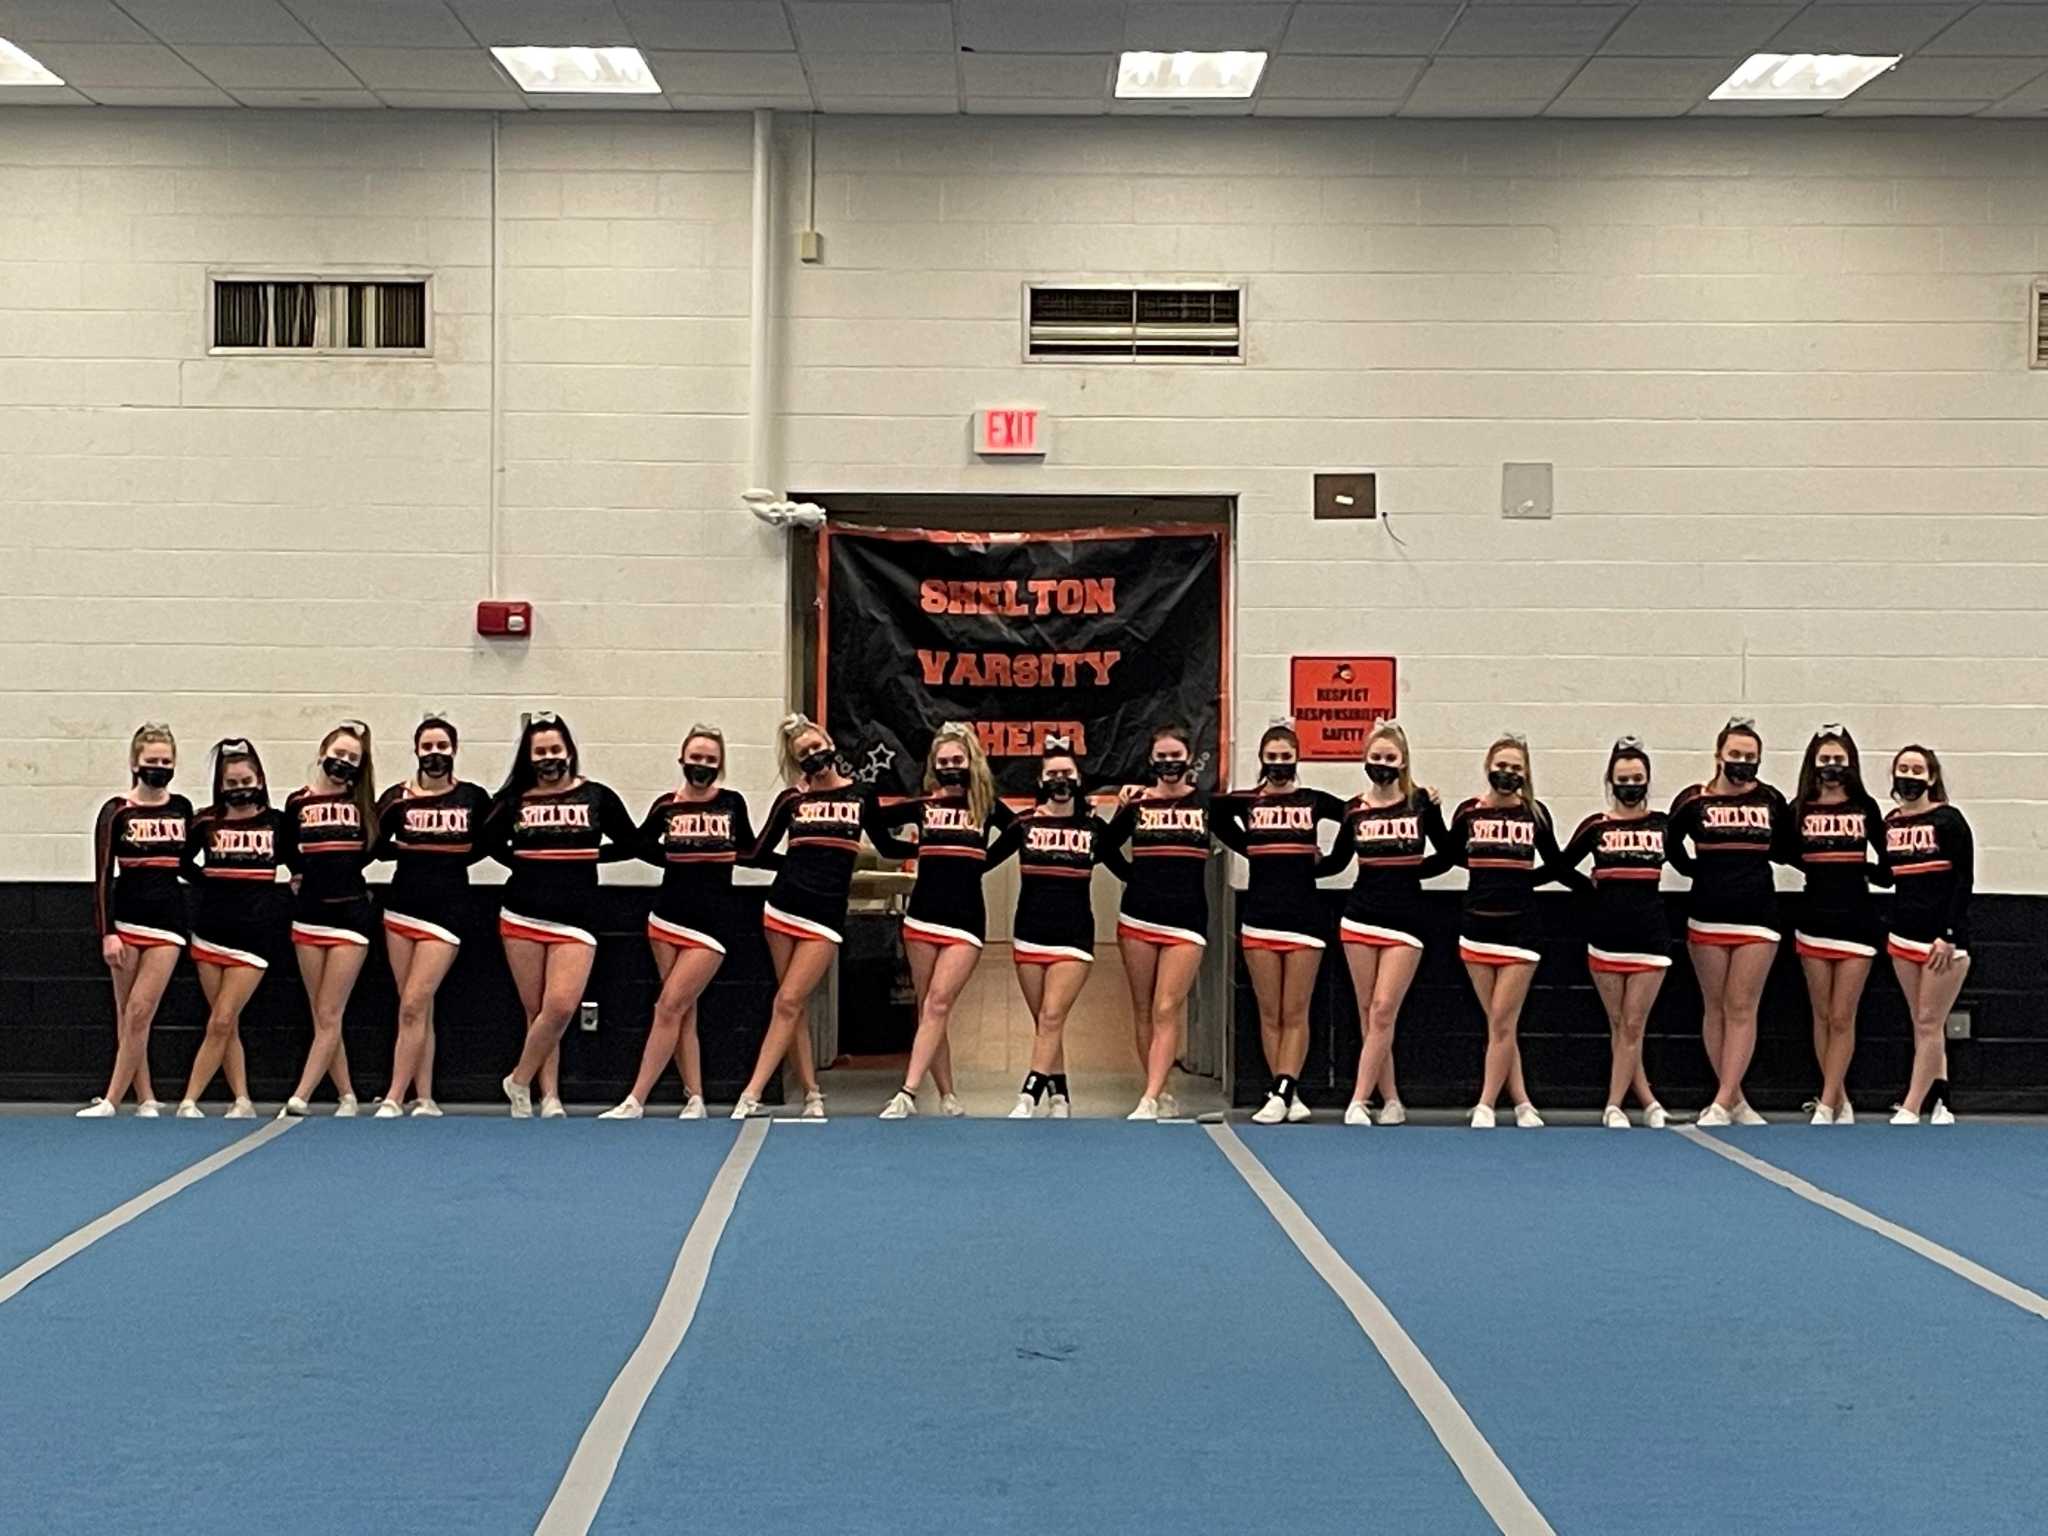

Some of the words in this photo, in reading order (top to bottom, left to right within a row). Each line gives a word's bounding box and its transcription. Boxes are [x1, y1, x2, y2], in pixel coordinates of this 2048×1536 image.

[987, 411, 1038, 449] EXIT
[920, 578, 1116, 616] SHELTON
[917, 649, 1121, 687] VARSITY
[1316, 688, 1369, 701] RESPECT
[1296, 708, 1391, 721] RESPONSIBILITY
[968, 721, 1087, 756] HEER
[1322, 728, 1364, 740] SAFETY
[403, 808, 470, 832] SHELTON
[519, 804, 591, 828] SHELTON
[796, 800, 859, 825] SHELTON
[1137, 806, 1205, 832] SHELTON
[1251, 806, 1312, 830] SHELTON
[1703, 804, 1770, 830] SHELTON
[126, 818, 185, 842] SHELTON
[669, 813, 732, 838] SHELTON
[1356, 816, 1418, 841] SHELTON
[1472, 819, 1534, 845] SHELTON
[1802, 813, 1867, 838] SHELTON
[210, 829, 274, 855] SHELTON
[1026, 827, 1092, 853] SHELTON
[1599, 828, 1664, 852] SHELTON
